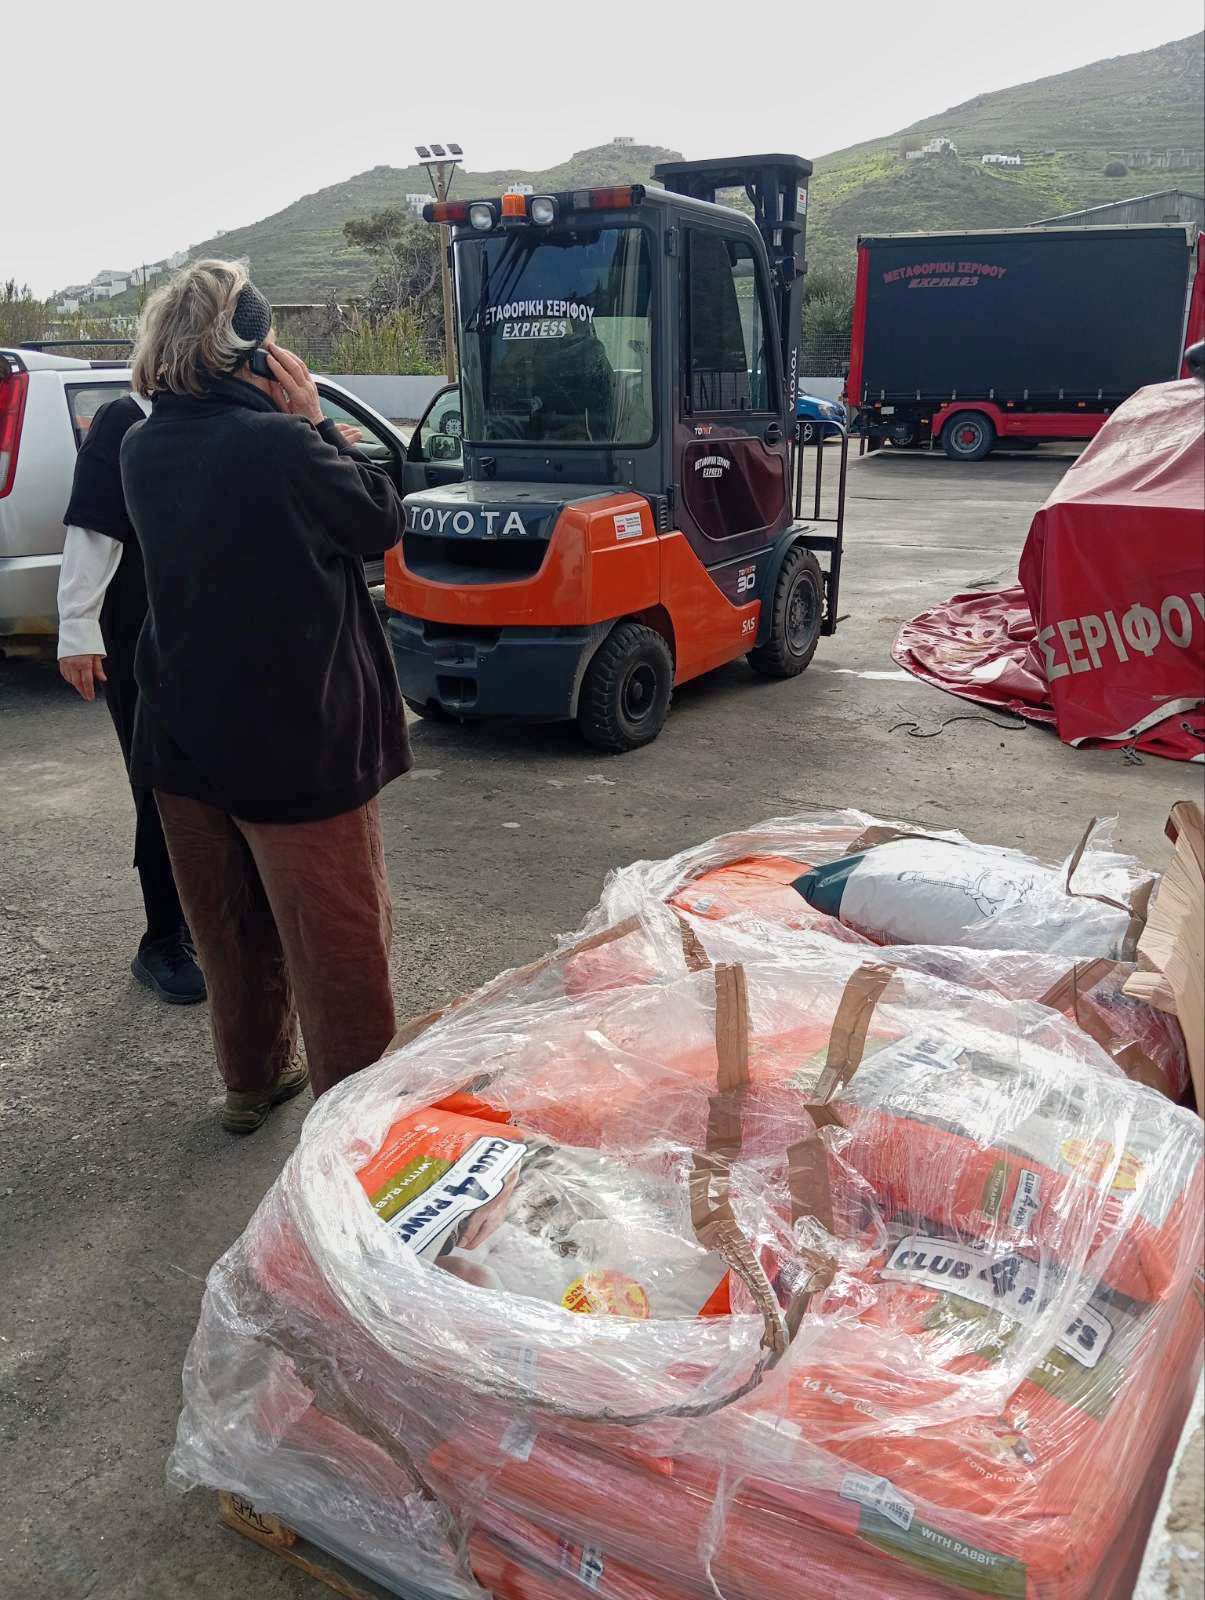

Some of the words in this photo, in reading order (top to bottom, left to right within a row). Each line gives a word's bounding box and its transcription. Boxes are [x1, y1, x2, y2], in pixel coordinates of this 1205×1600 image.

[476, 300, 544, 327] ΕΤΑΦΟΡΙΚΗ
[546, 300, 595, 323] ΣΕΡΙΦΟΥ
[502, 321, 567, 338] EXPRESS
[789, 346, 798, 412] TOYOTA
[410, 505, 527, 535] TOYOTA
[737, 574, 756, 593] 30
[742, 617, 756, 633] SAS
[468, 1140, 509, 1174] CLUB
[400, 1161, 432, 1186] WITH
[374, 1187, 403, 1213] RAB
[443, 1176, 490, 1201] 4
[893, 1250, 973, 1280] CLUB
[921, 1526, 952, 1548] WITH
[953, 1541, 997, 1566] RABBIT
